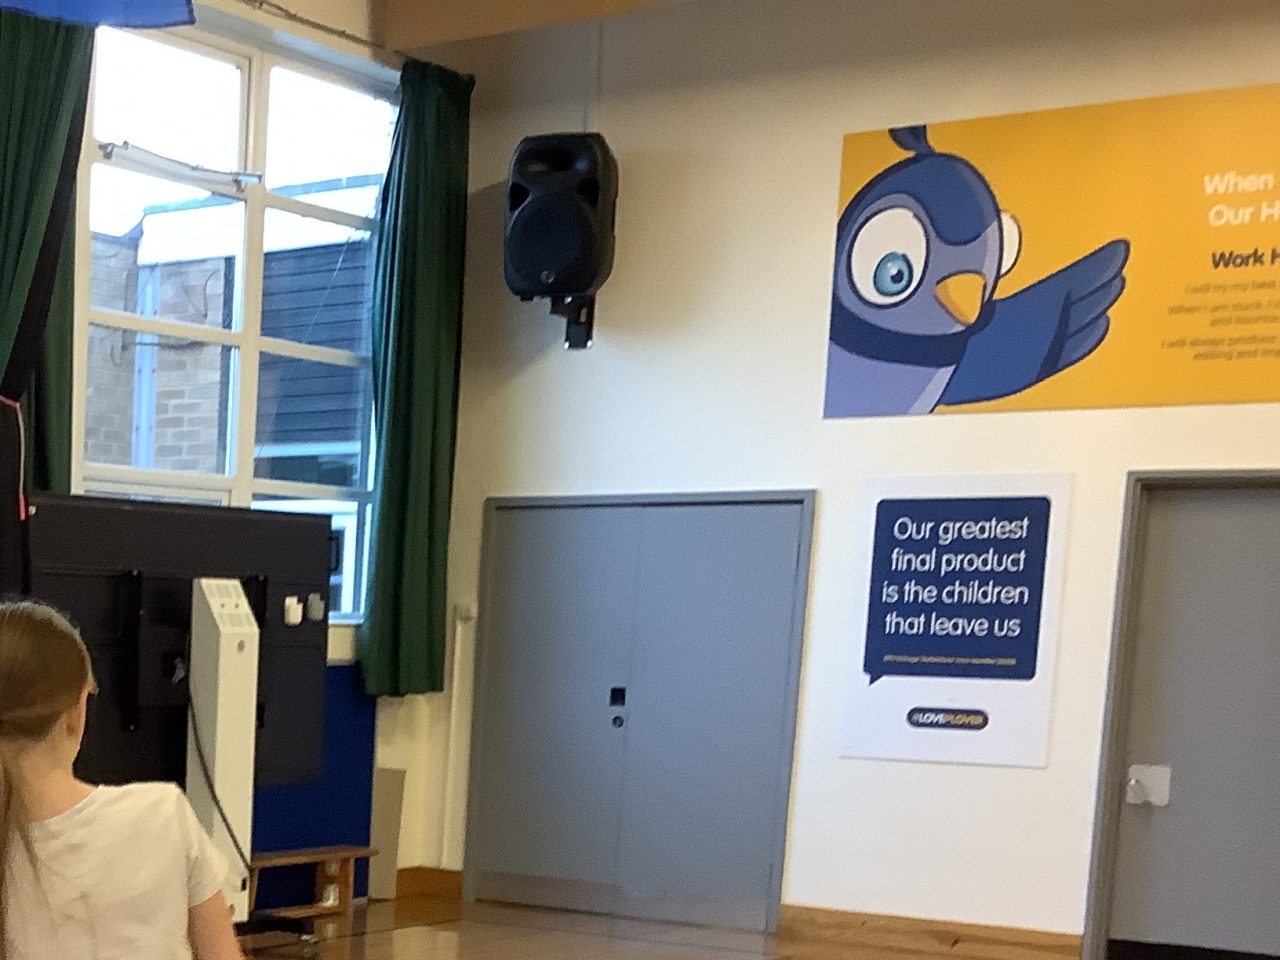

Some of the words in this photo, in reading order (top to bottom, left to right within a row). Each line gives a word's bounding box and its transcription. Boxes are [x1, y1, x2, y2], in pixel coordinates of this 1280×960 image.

[1203, 171, 1274, 195] When
[1208, 204, 1254, 227] Our
[1212, 248, 1265, 270] Work
[893, 516, 935, 540] Our
[938, 516, 1030, 546] greatest
[891, 546, 937, 572] final
[940, 546, 1026, 578] product
[881, 580, 899, 603] is
[903, 579, 938, 603] the
[942, 579, 1030, 605] children
[885, 611, 926, 635] that
[930, 611, 990, 637] leave
[993, 617, 1022, 637] us
